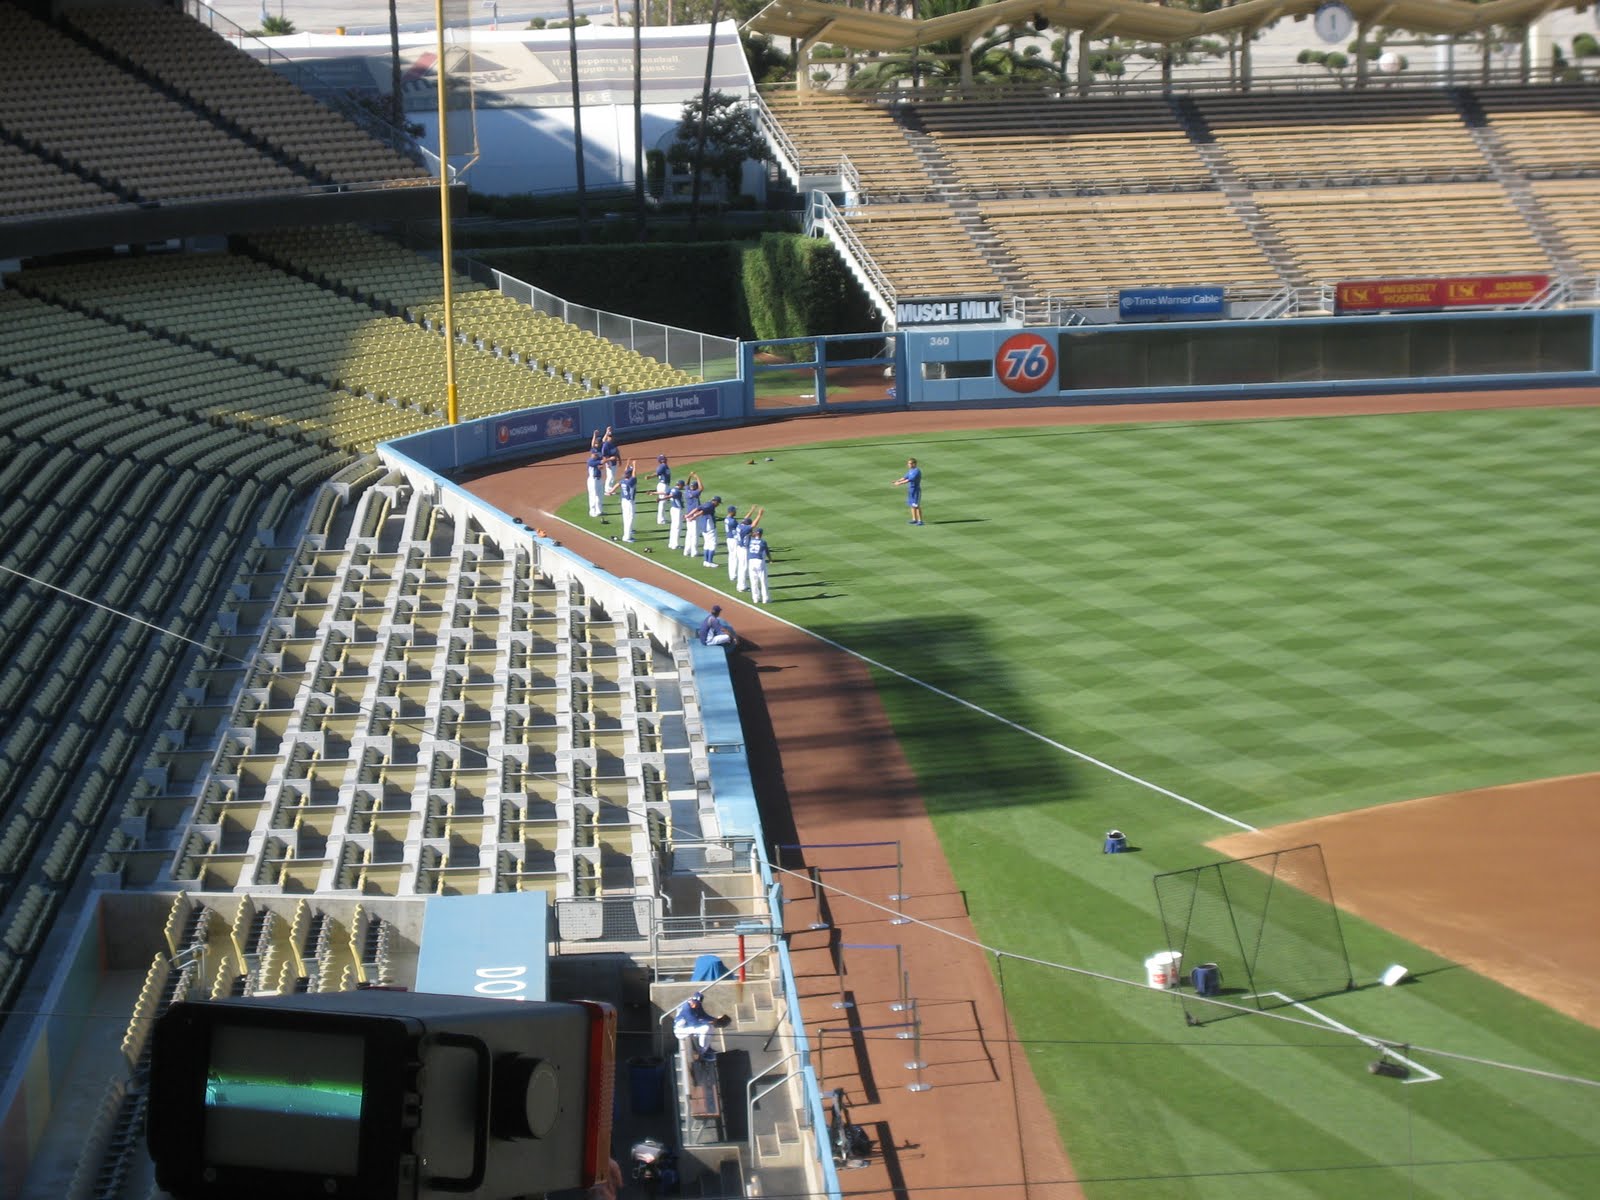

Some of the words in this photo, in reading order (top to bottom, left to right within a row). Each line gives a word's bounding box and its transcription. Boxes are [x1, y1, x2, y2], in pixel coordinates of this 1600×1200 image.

[571, 57, 619, 67] appens
[633, 55, 680, 64] aseball
[571, 65, 617, 74] appens
[1134, 296, 1157, 306] Time
[1157, 296, 1192, 305] Warner
[1192, 294, 1219, 304] Cable
[1383, 293, 1432, 303] HOSPITAL
[897, 303, 958, 323] MUSCLE
[960, 301, 1001, 320] MILK
[929, 336, 950, 346] 360
[1003, 344, 1049, 380] 76
[647, 397, 673, 411] Merrill
[675, 394, 699, 408] Lynch
[749, 543, 761, 554] 29
